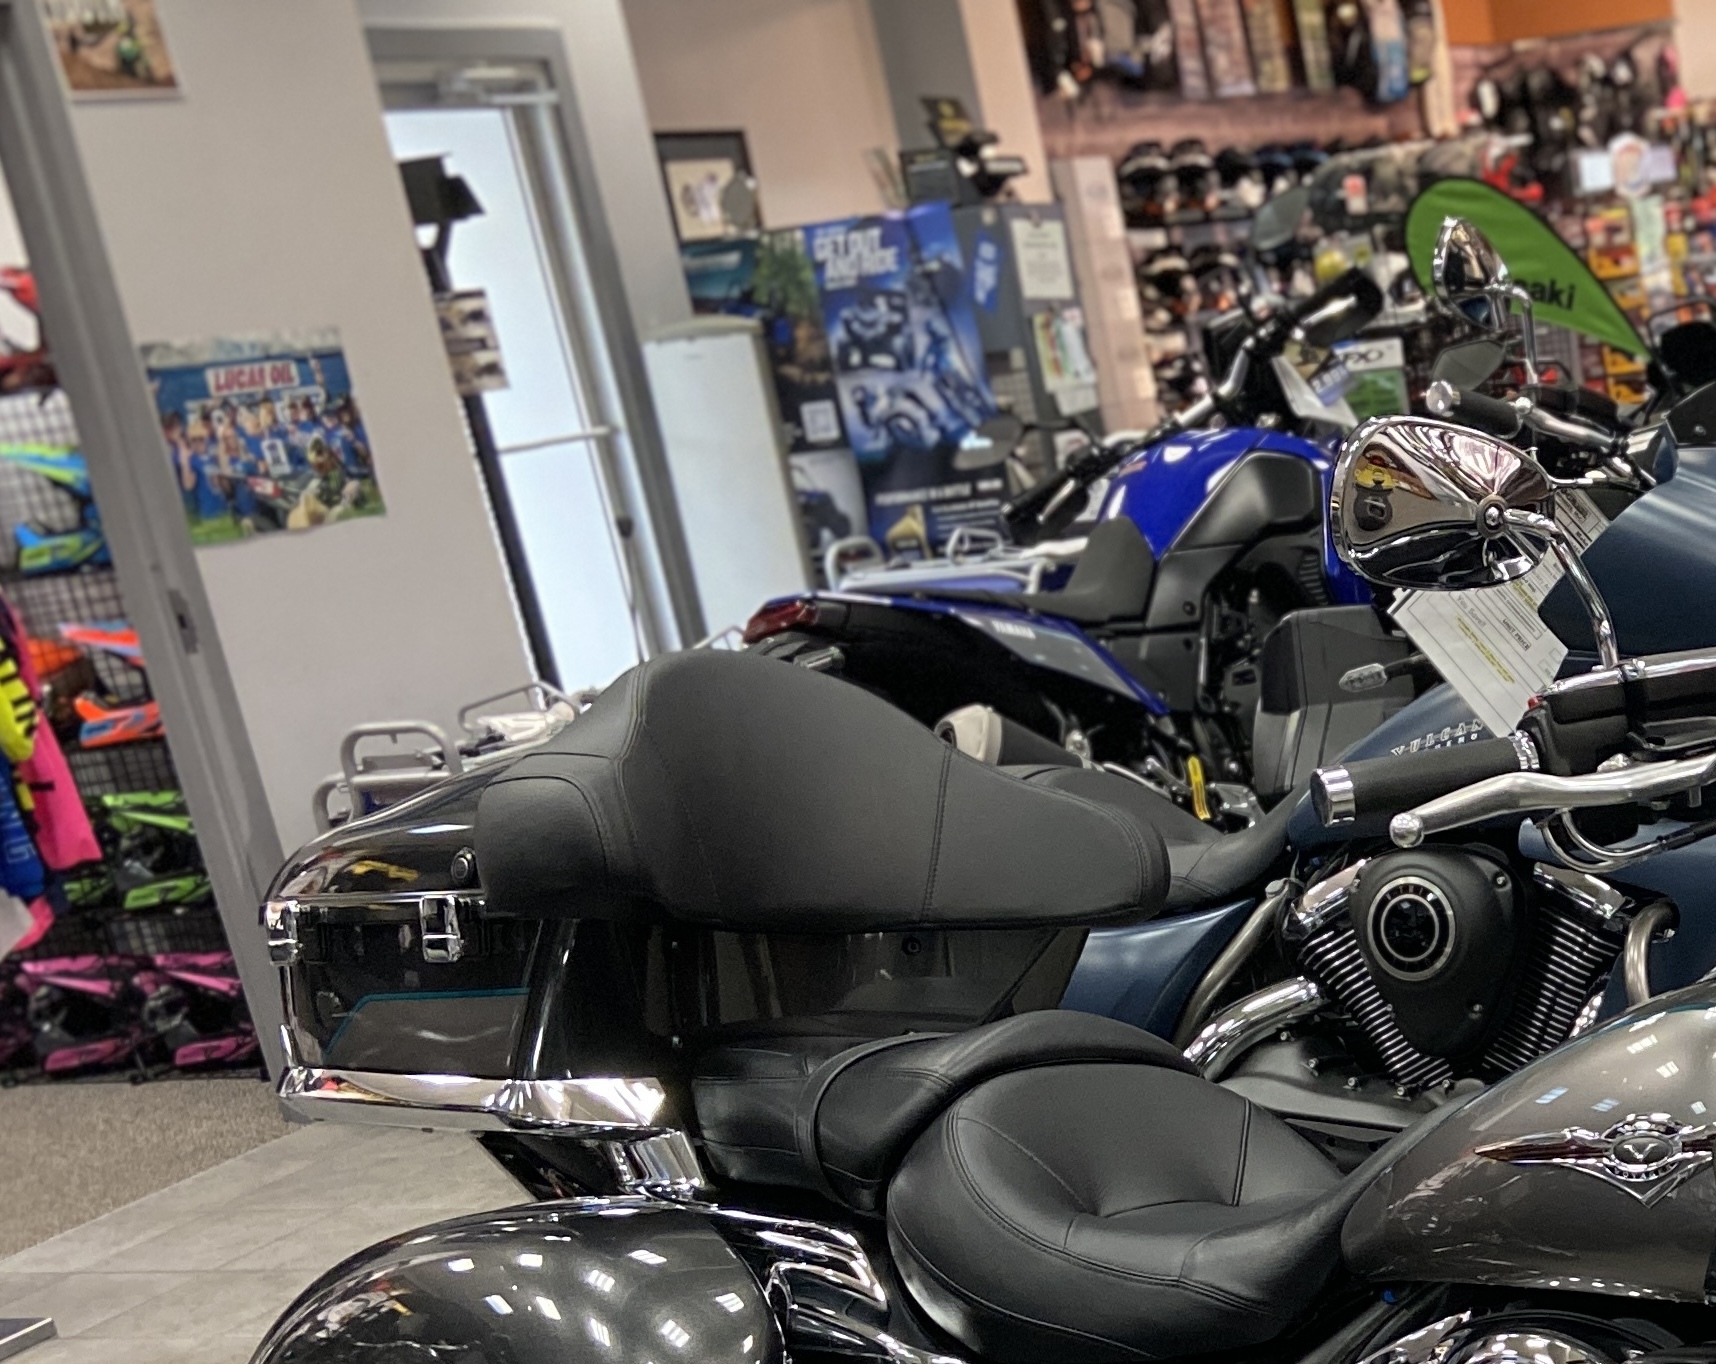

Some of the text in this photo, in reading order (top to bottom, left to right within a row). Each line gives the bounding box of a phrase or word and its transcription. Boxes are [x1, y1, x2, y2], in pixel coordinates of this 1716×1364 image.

[213, 361, 295, 393] LUCAS OIL
[1390, 718, 1484, 757] VULCAN
